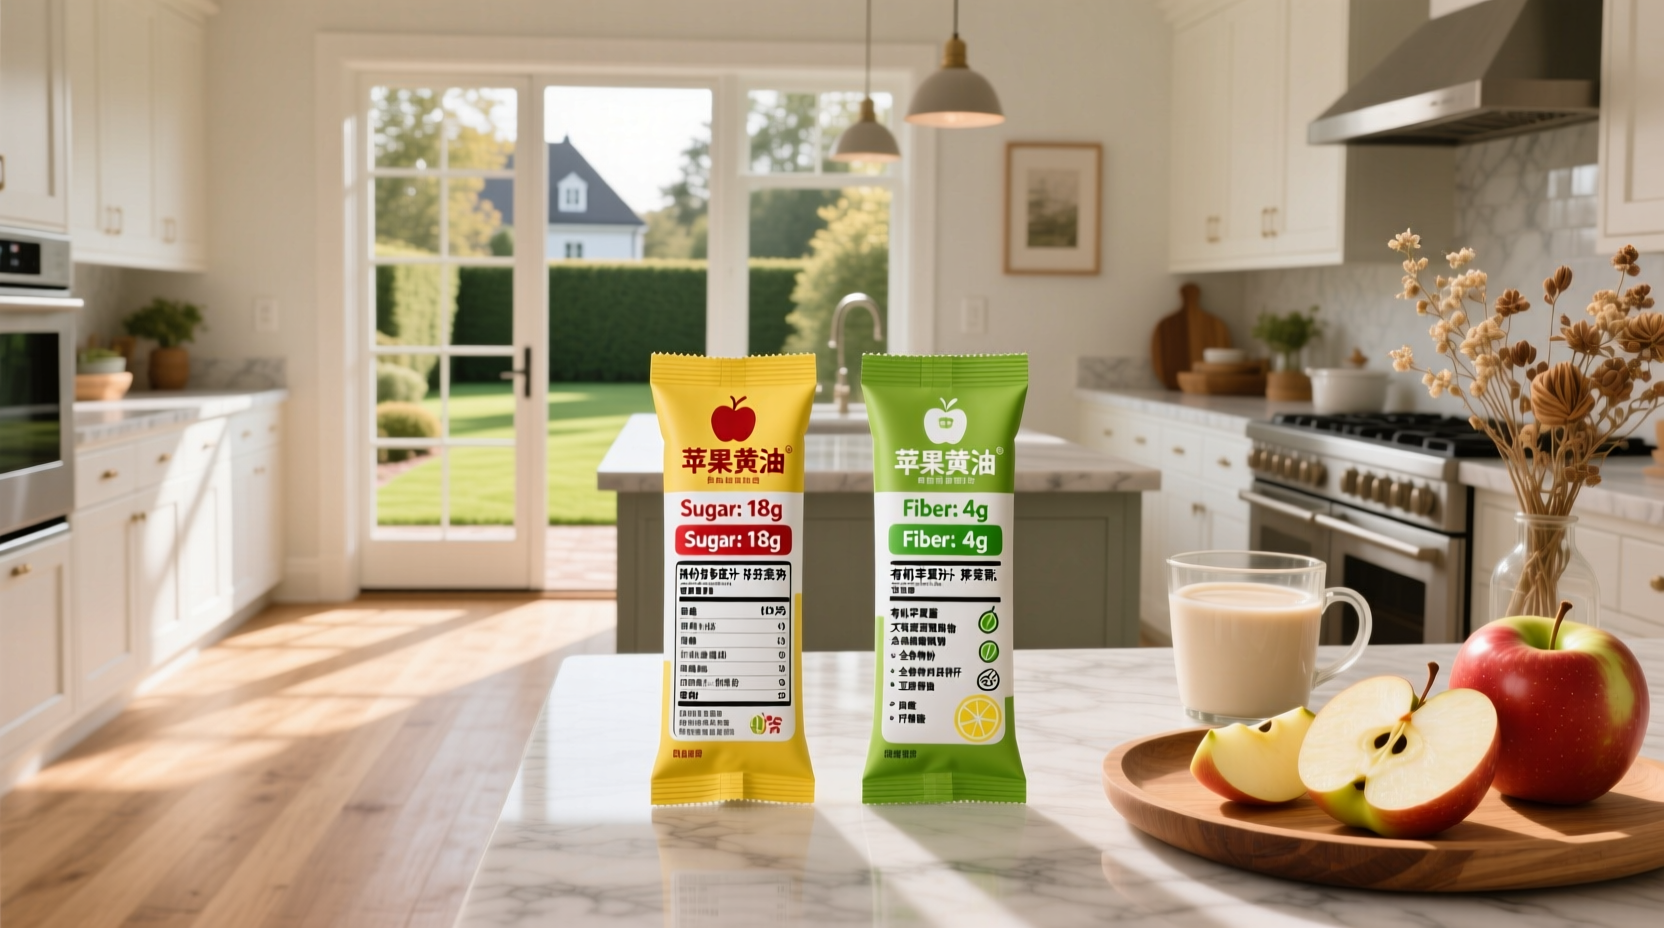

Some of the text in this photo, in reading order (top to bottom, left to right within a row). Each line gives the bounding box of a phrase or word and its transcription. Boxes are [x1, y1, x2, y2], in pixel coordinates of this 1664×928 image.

[682, 447, 785, 474] 苹果黄油
[894, 448, 995, 475] 苹果黄油
[681, 499, 782, 521] Sugar: 18g
[903, 498, 988, 522] Fiber: 4g
[684, 530, 780, 552] Sugar: 18g
[903, 530, 987, 553] Fiber: 4g
